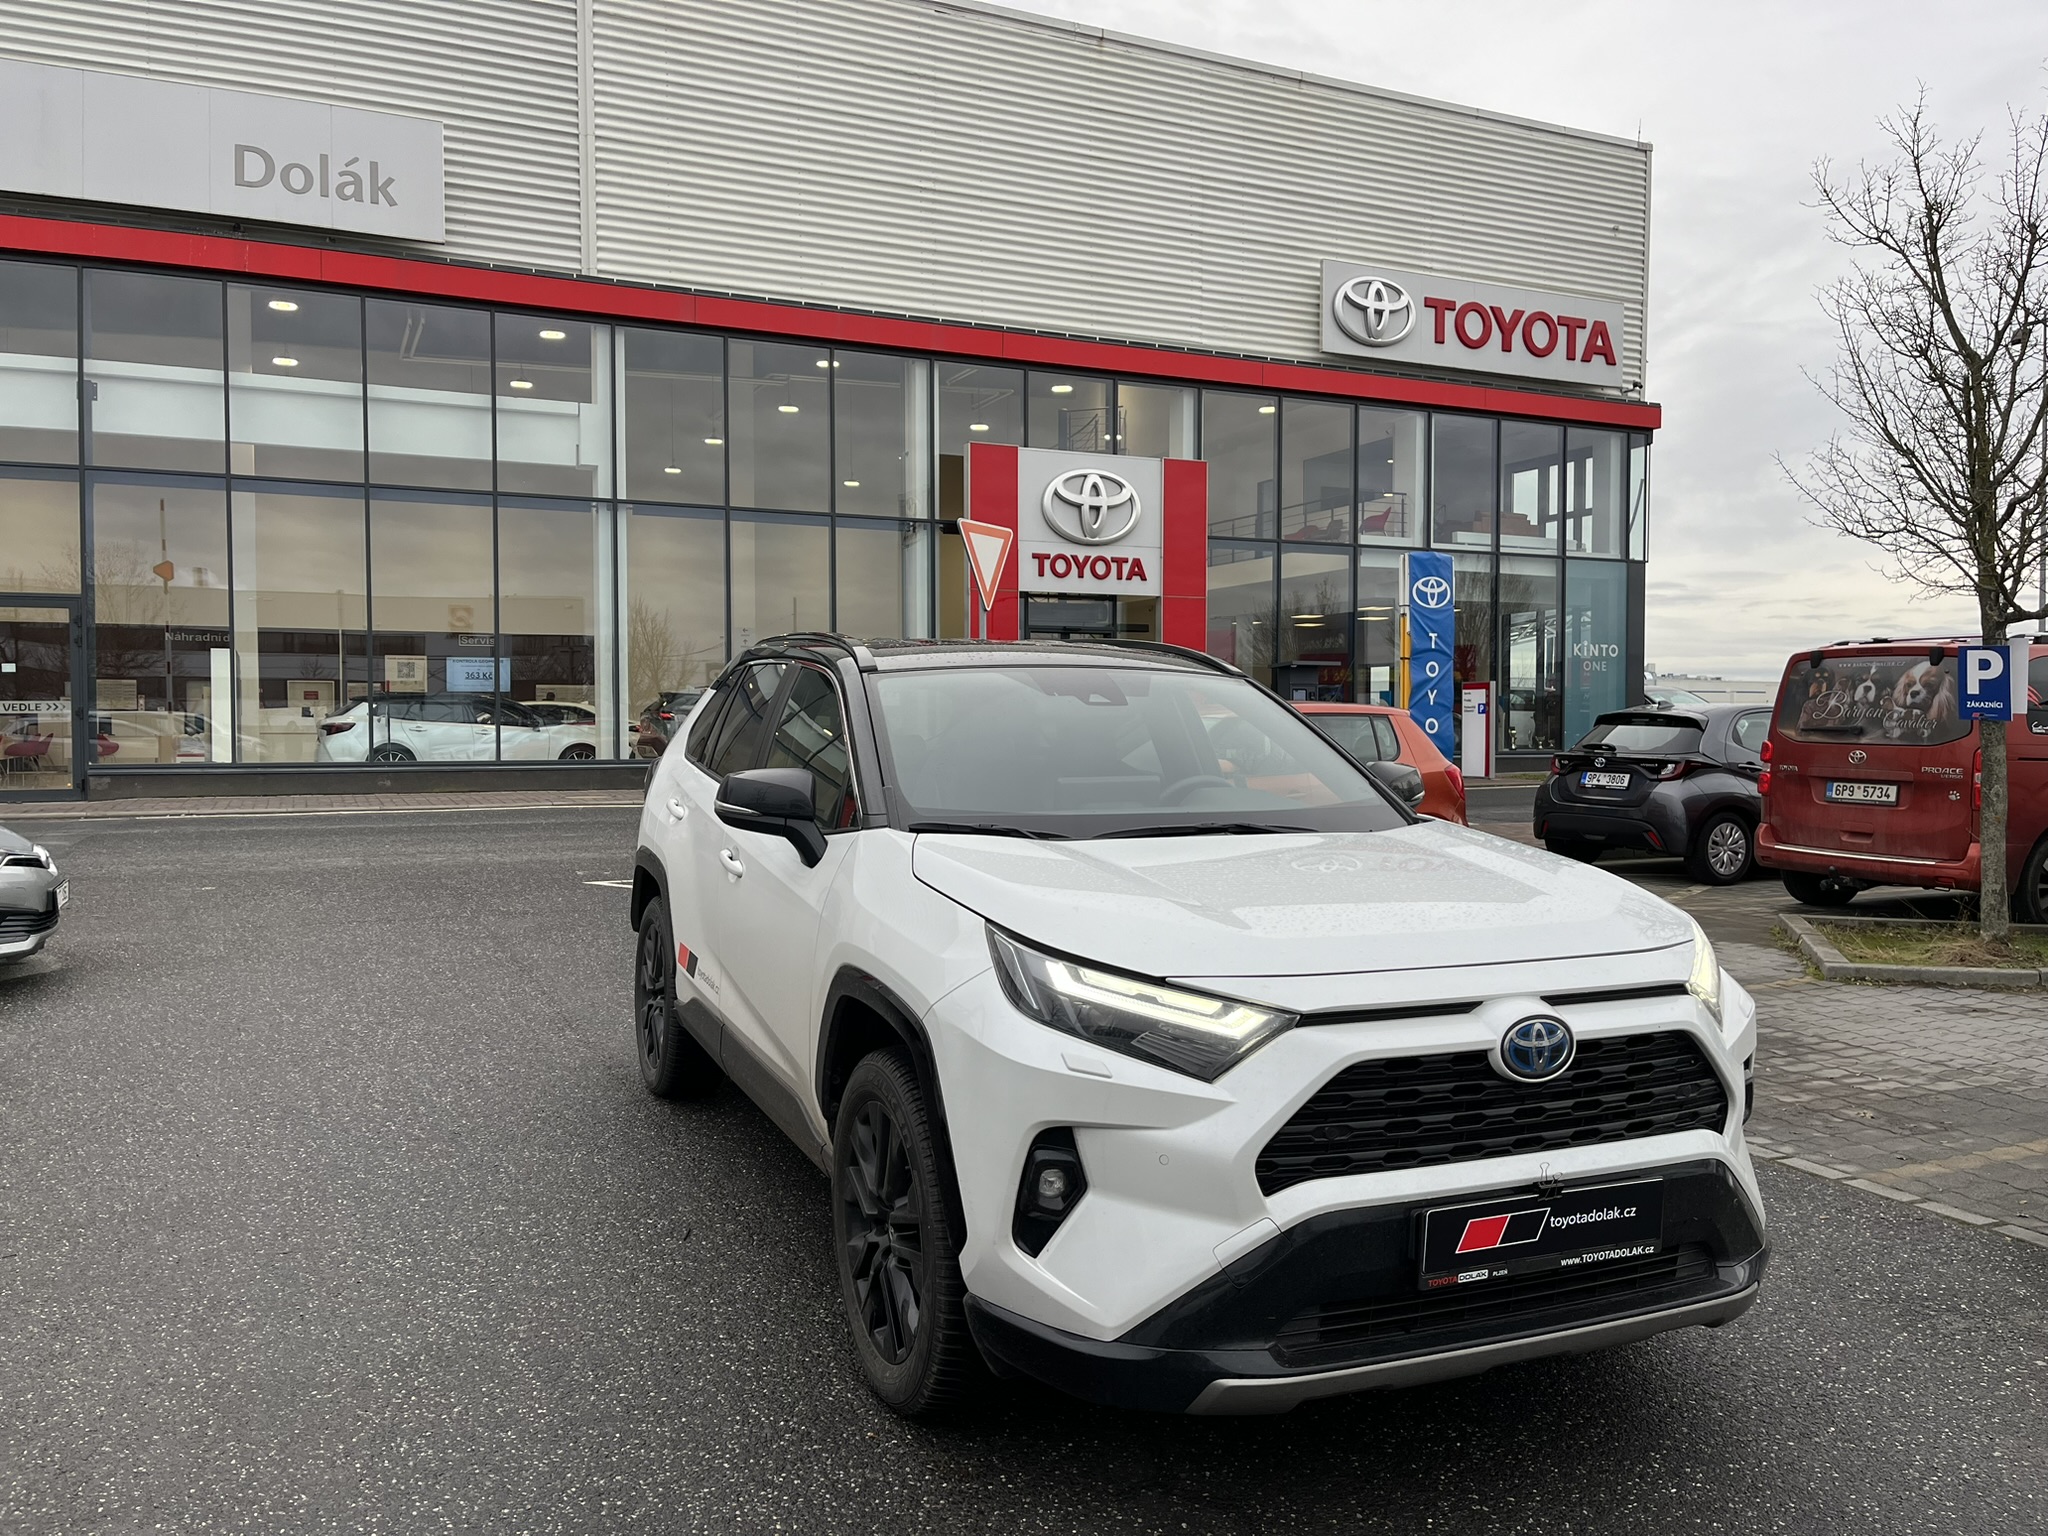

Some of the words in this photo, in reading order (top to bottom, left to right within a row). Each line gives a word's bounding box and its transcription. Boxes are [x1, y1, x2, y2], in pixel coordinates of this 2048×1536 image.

[234, 143, 398, 207] Dolák
[1424, 296, 1617, 366] TOYOTA
[1031, 552, 1148, 581] TOYOTA
[461, 636, 494, 645] Servis
[1583, 660, 1607, 671] ONE
[1966, 649, 2004, 695] P
[464, 671, 481, 680] 363
[3, 702, 42, 712] VEDLE
[1966, 700, 2004, 709] ZÁKAZNÍCI
[1882, 709, 1938, 729] Cavalier
[1921, 766, 1964, 775] PROACE
[1587, 773, 1601, 784] 9P4
[1605, 775, 1626, 785] 3806
[1834, 784, 1855, 798] 6P9
[1862, 785, 1891, 800] 5734
[1549, 1205, 1637, 1230] toyotadolak.cz
[1560, 1244, 1655, 1267] www.TOYOTADOLAK.cz
[1428, 1275, 1457, 1287] TOYOTA
